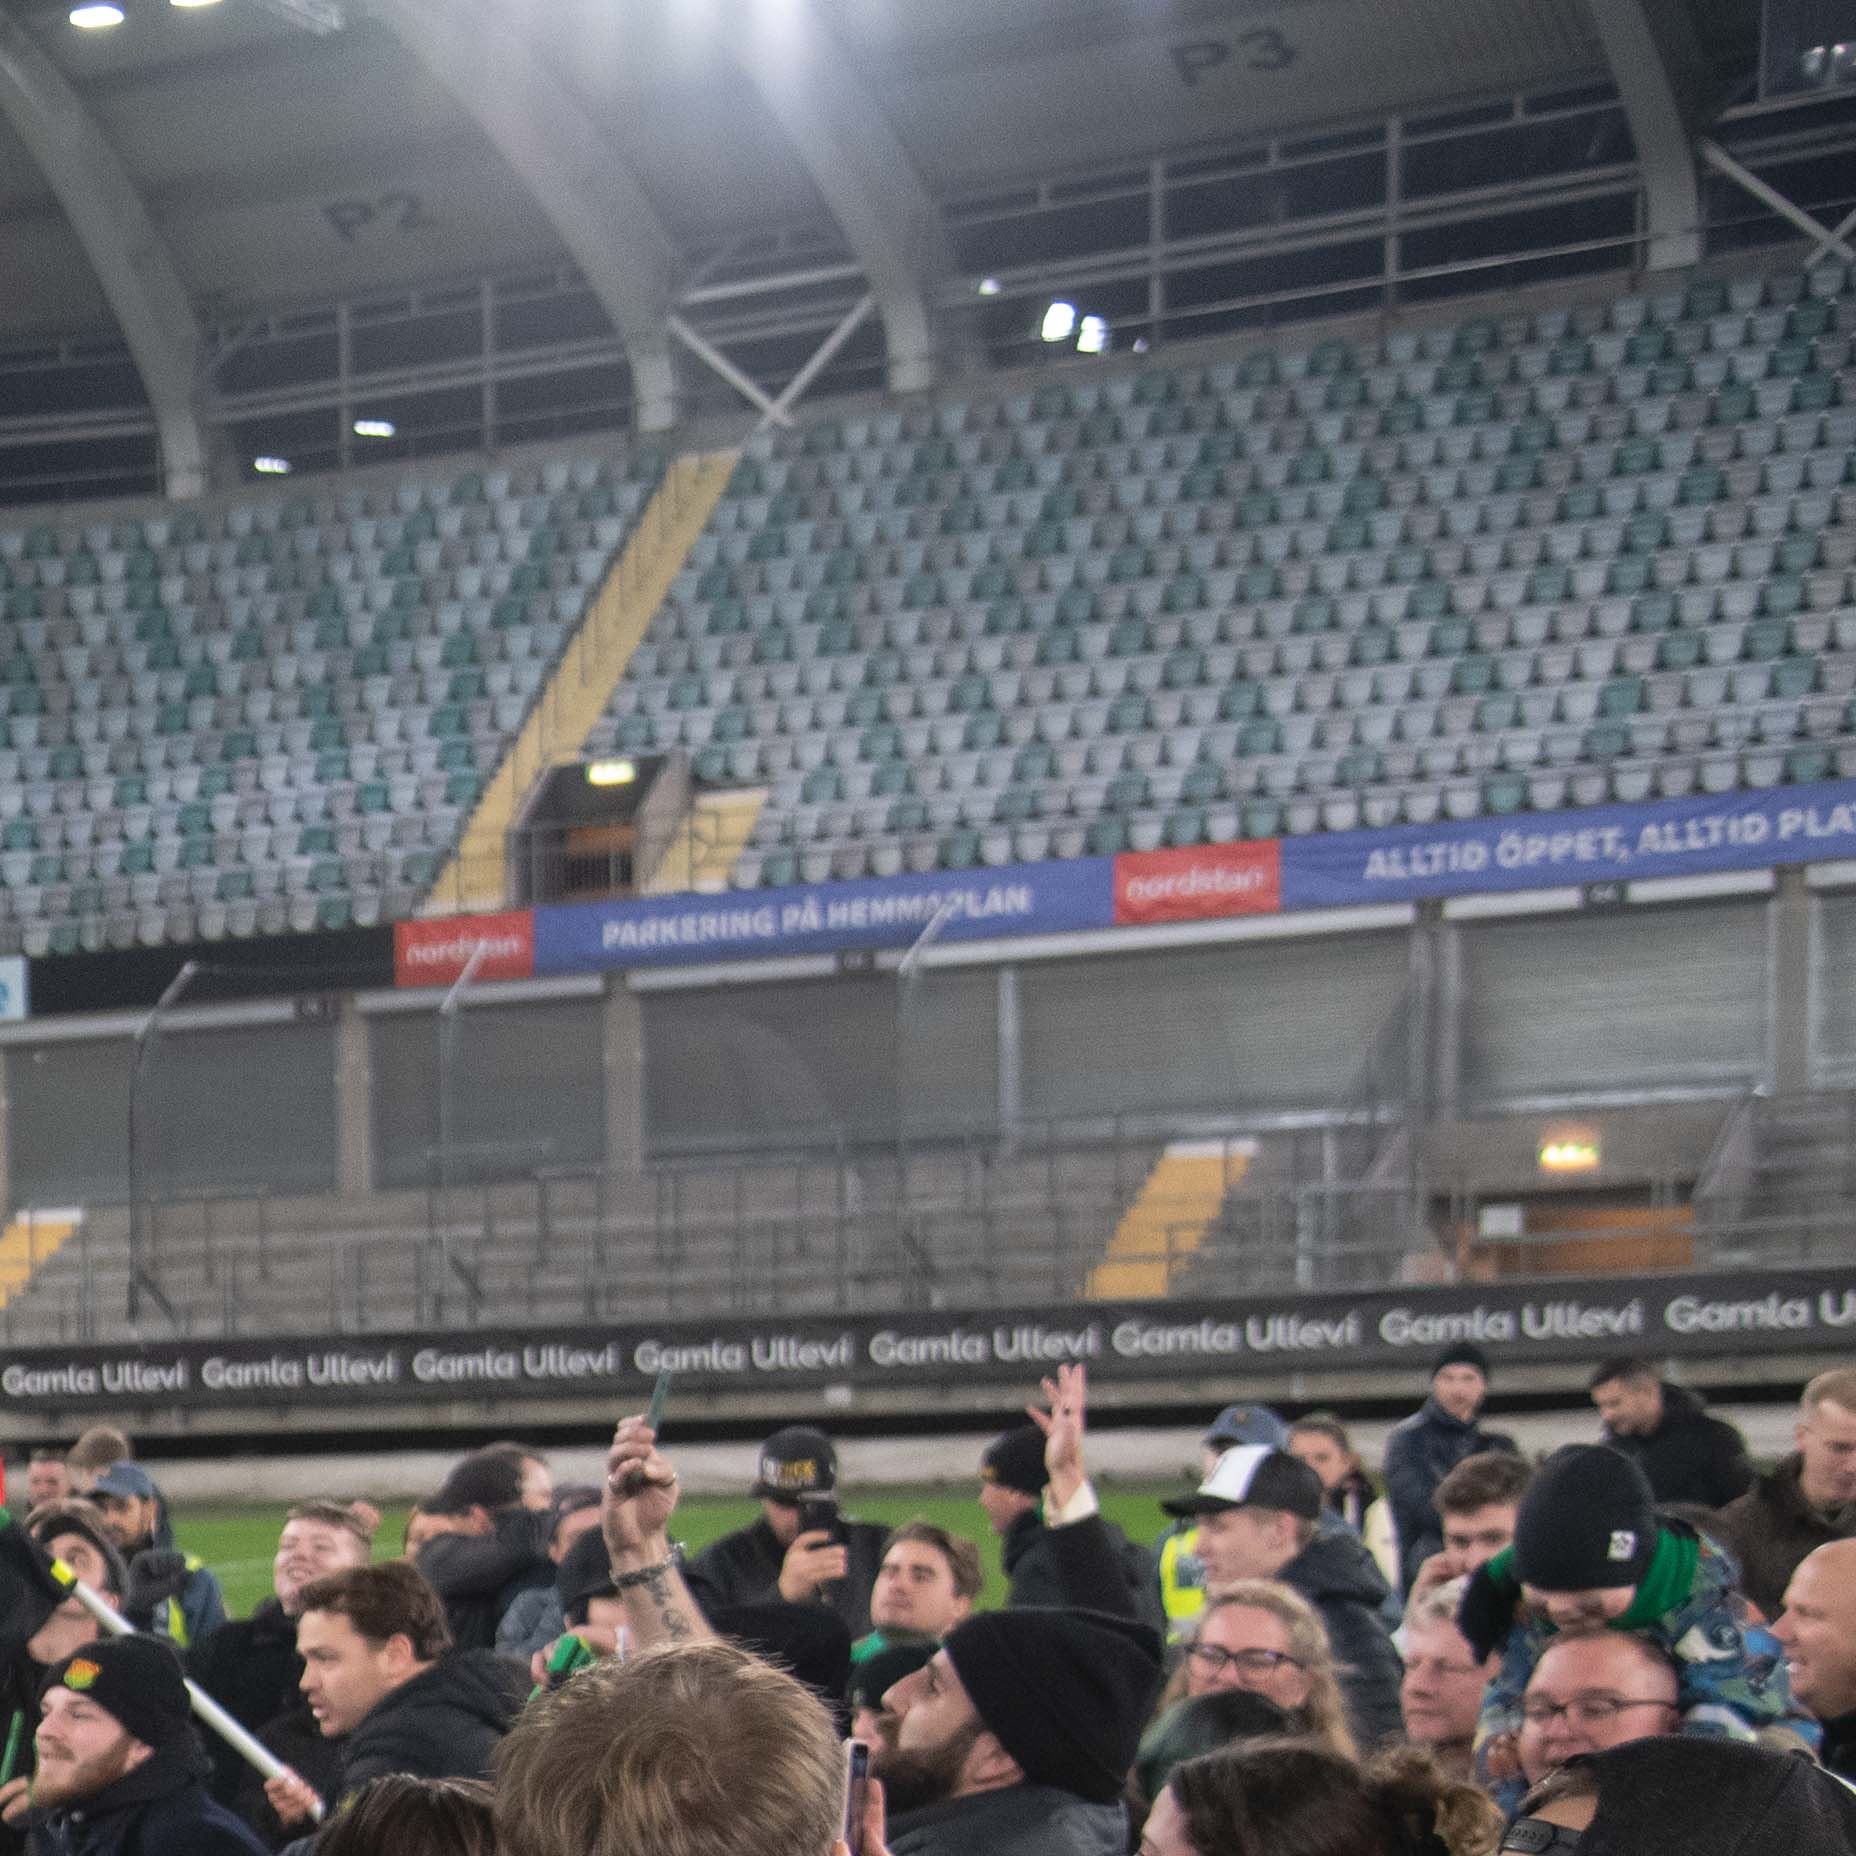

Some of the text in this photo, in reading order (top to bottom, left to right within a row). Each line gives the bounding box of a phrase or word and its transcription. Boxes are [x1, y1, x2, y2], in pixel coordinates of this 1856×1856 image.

[1170, 26, 1298, 88] P3
[322, 190, 436, 243] P2
[1364, 841, 1485, 882] ALLTID
[1634, 811, 1769, 856] ALLTID
[601, 911, 777, 949] PARKERING
[781, 894, 821, 934] PÅ
[1112, 1312, 1357, 1359] Gamla Ullevi
[1379, 1299, 1642, 1348] Gamla Ullevi
[1664, 1293, 1812, 1335] Gamla
[412, 1344, 618, 1383] Gamla Ullevi
[634, 1333, 852, 1374] Gamla Ullevi
[870, 1322, 1097, 1366] Gamla Ullevi
[2, 1359, 188, 1397] Gamla Ullevi
[202, 1351, 396, 1391] Gamla Ullevi
